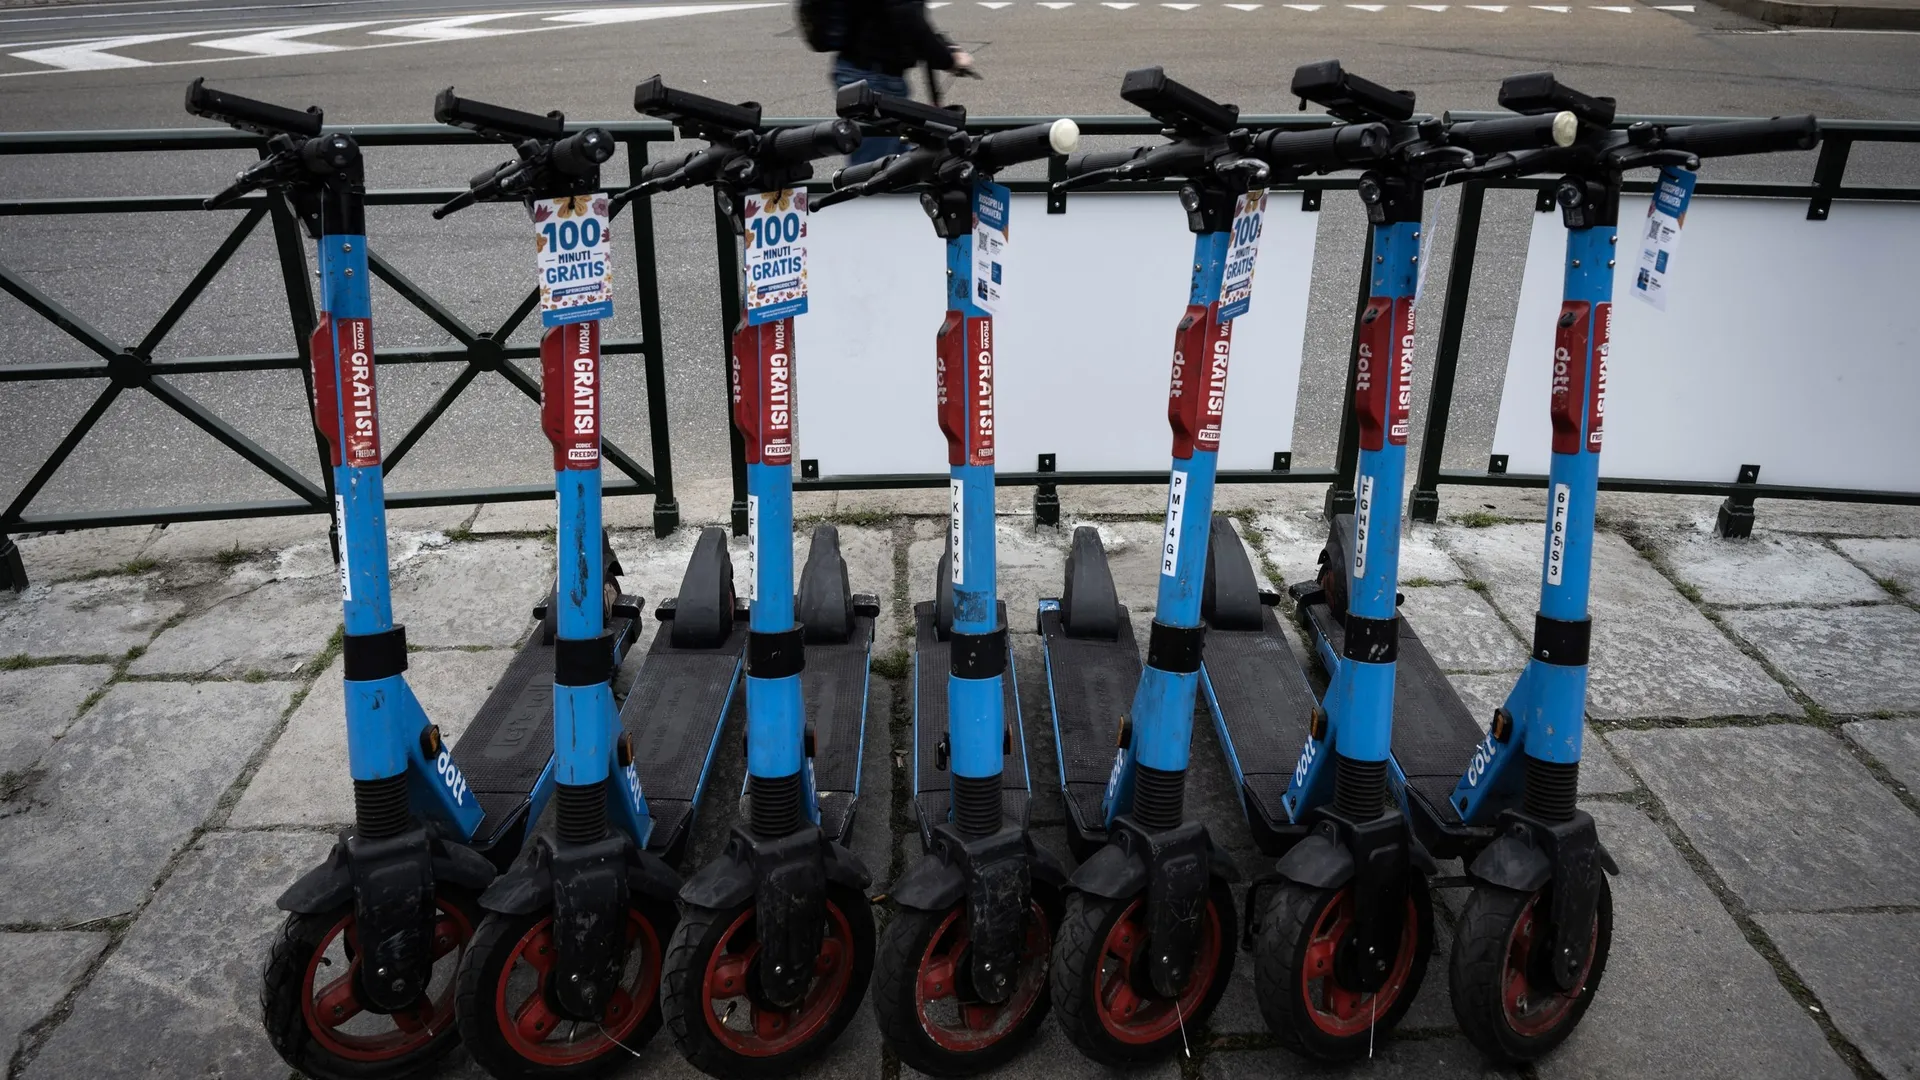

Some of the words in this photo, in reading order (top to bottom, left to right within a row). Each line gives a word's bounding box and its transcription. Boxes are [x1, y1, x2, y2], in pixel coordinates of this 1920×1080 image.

[542, 218, 601, 253] 100
[750, 212, 800, 249] 100
[763, 246, 790, 260] MINUTI
[1234, 212, 1260, 249] 100
[1234, 246, 1251, 260] MINUTI
[546, 260, 604, 284] GRATIS
[558, 250, 591, 264] MINUTI
[752, 256, 802, 281] GRATIS
[1226, 256, 1254, 280] GRATIS
[356, 321, 365, 350] PROVA
[579, 322, 590, 354] PROVA
[937, 357, 948, 405] dott
[1169, 350, 1185, 398] dott
[1207, 340, 1230, 416] GRATIS!
[1356, 342, 1373, 391] dott
[1398, 334, 1414, 411] GRATIS!
[1552, 346, 1571, 395] dott
[351, 352, 373, 436] GRATIS!
[573, 358, 594, 434] GRATIS!
[770, 353, 788, 430] GRATIS!
[978, 351, 993, 436] GRATIS!
[1164, 477, 1182, 571] PMT4GR
[1355, 485, 1369, 568] FGHSJD
[1550, 492, 1565, 576] 6F65S3
[437, 751, 467, 807] dott
[1295, 733, 1316, 788] dott
[1467, 733, 1497, 787] dott
